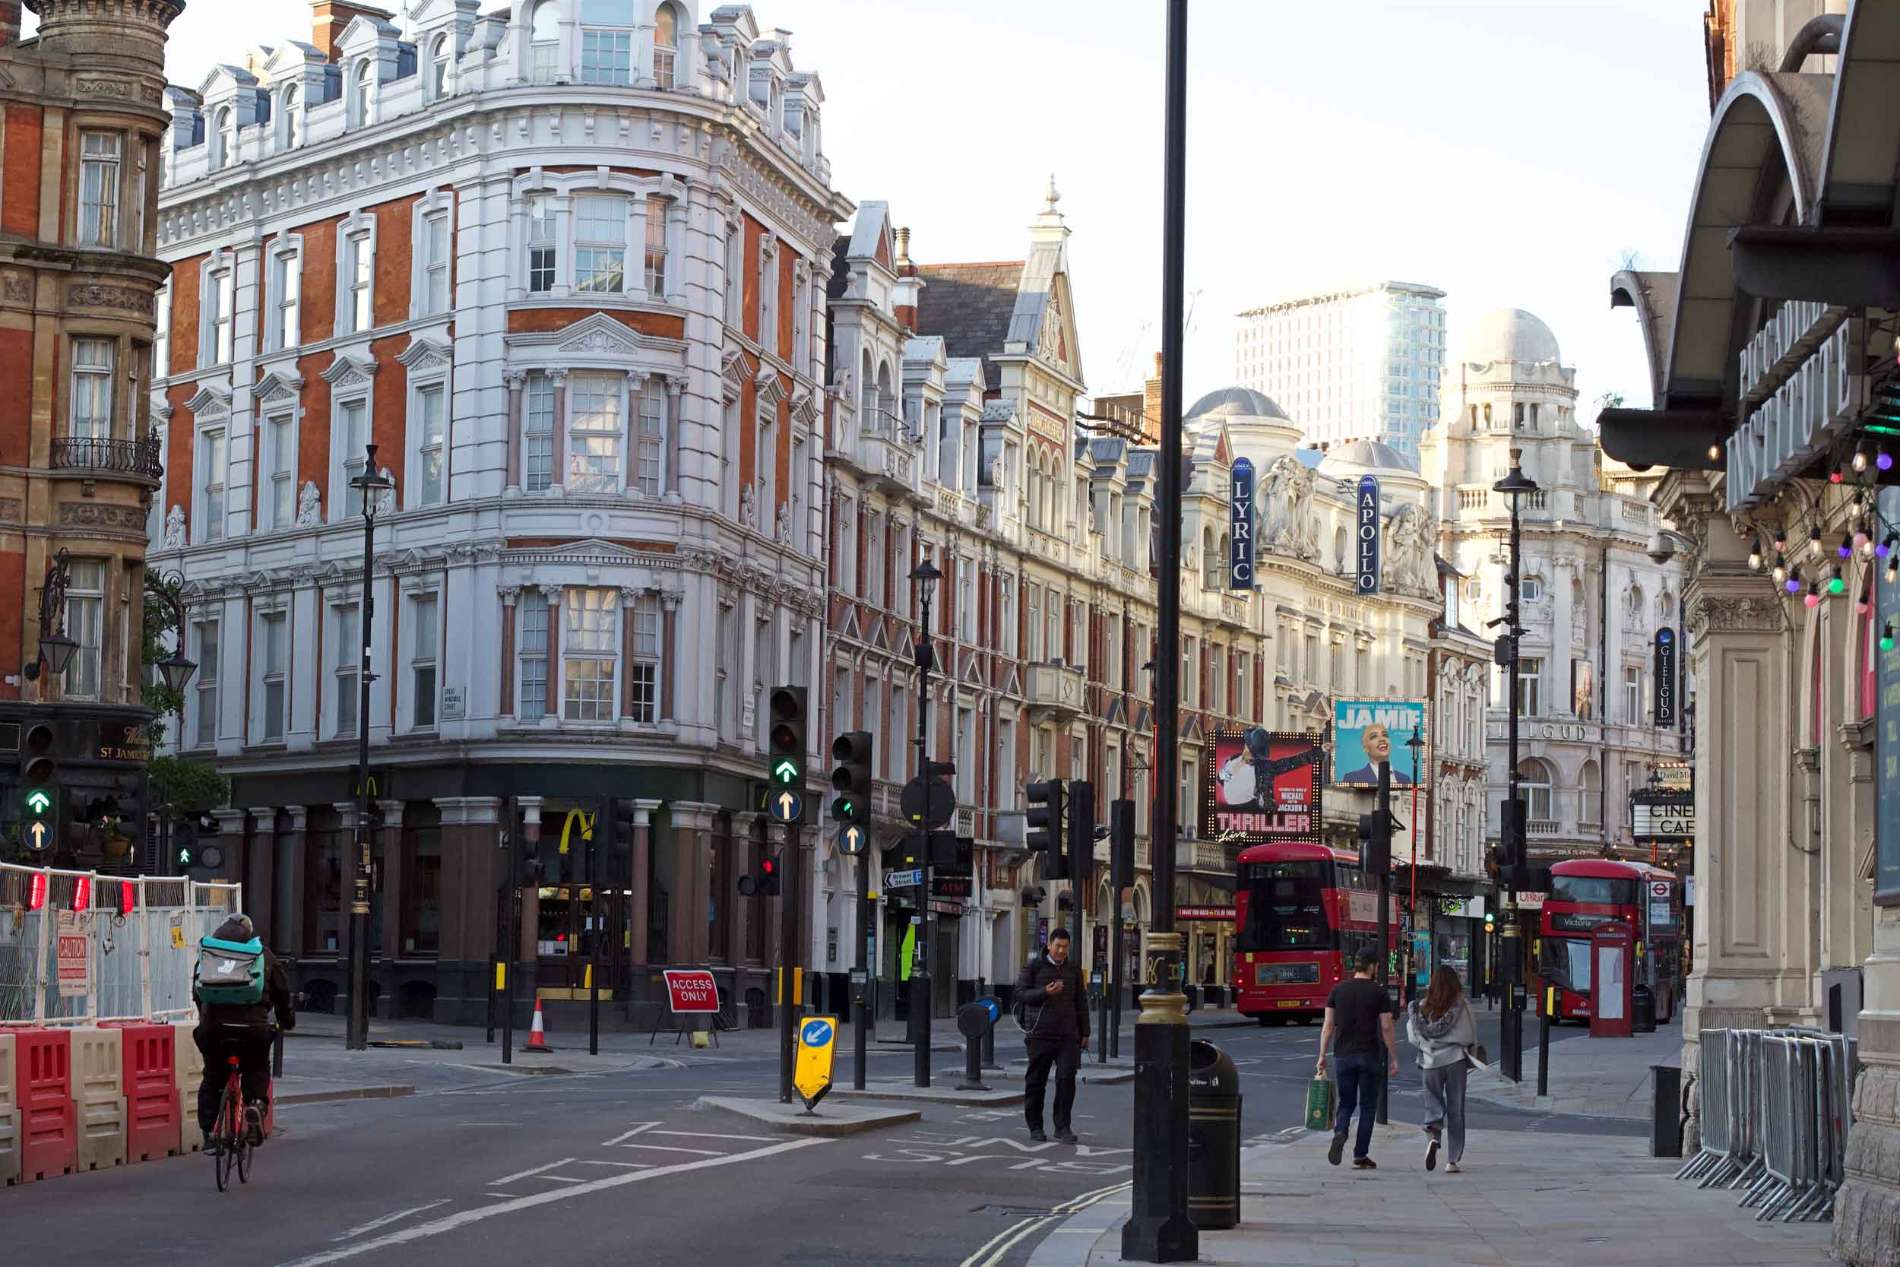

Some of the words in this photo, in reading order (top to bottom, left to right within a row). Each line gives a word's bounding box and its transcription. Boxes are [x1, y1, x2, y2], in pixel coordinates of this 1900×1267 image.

[1233, 482, 1250, 580] LYRIC
[1359, 493, 1376, 589] APOLLO
[1660, 645, 1669, 718] GIELGUD
[1337, 708, 1420, 730] JAMIE
[1217, 813, 1310, 832] THRILLER
[1564, 919, 1591, 927] Victoria
[60, 939, 85, 957] CAUTION
[672, 978, 712, 990] ACCESS
[681, 990, 708, 1001] ONLY
